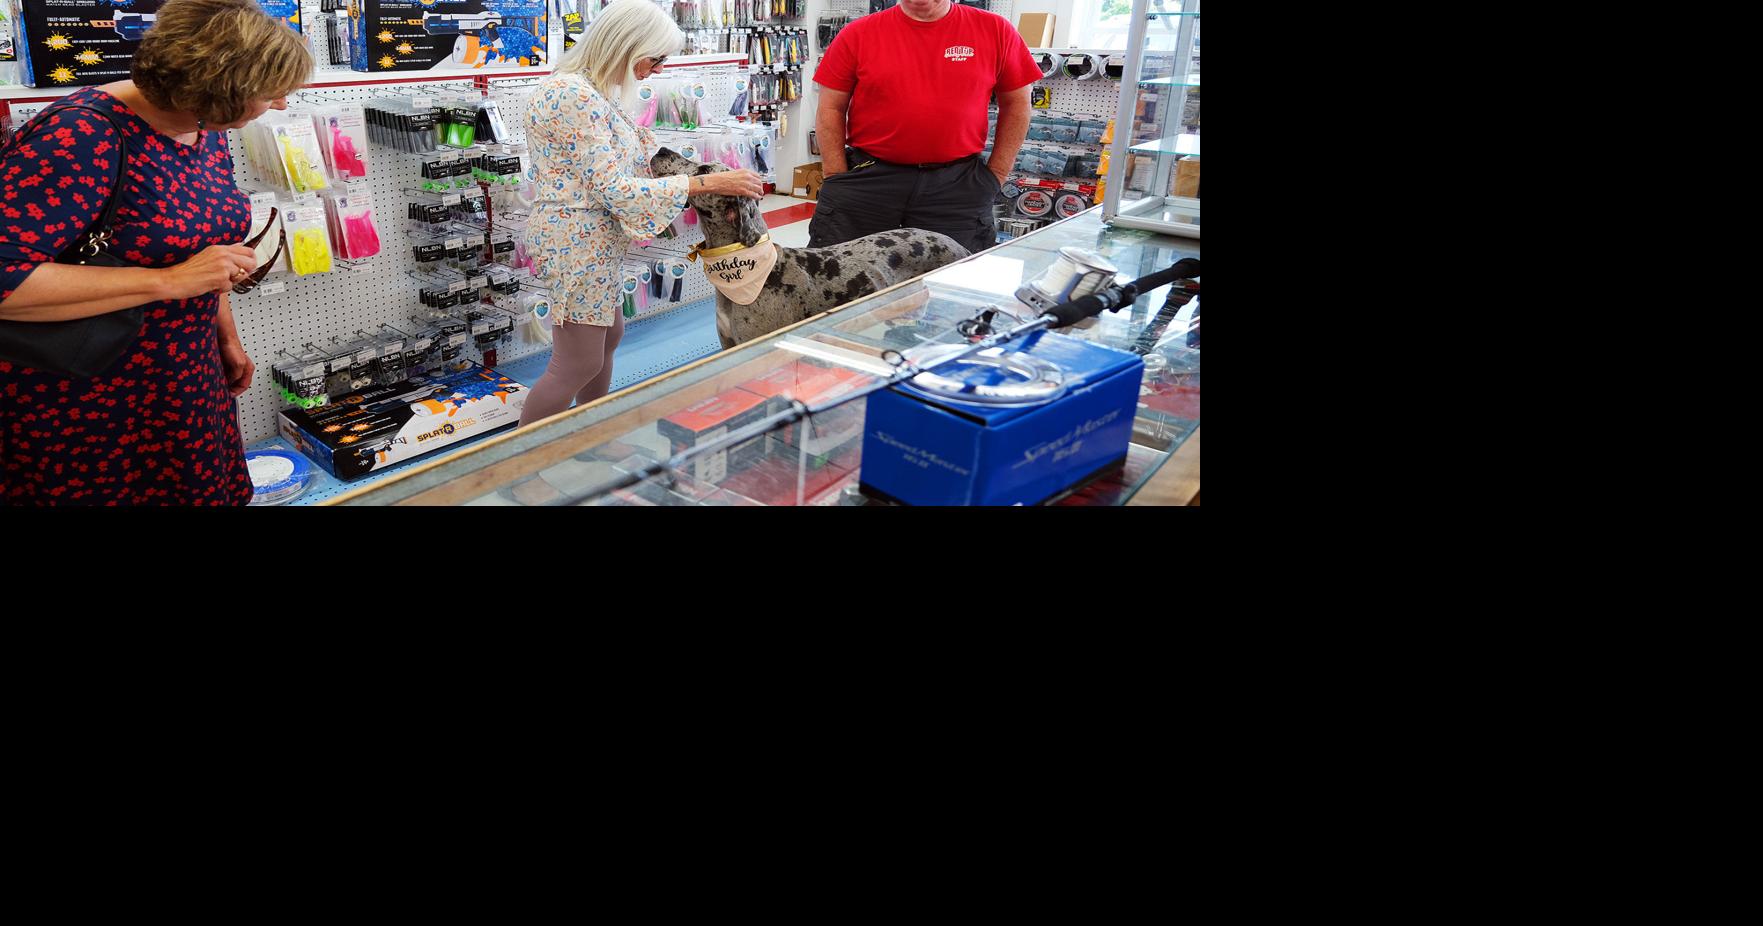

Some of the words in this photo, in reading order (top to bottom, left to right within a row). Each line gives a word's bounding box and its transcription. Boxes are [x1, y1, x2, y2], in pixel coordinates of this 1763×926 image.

[455, 109, 477, 118] NLBN
[421, 245, 441, 253] NLBN
[719, 269, 743, 283] Girl
[381, 354, 400, 362] NLBN
